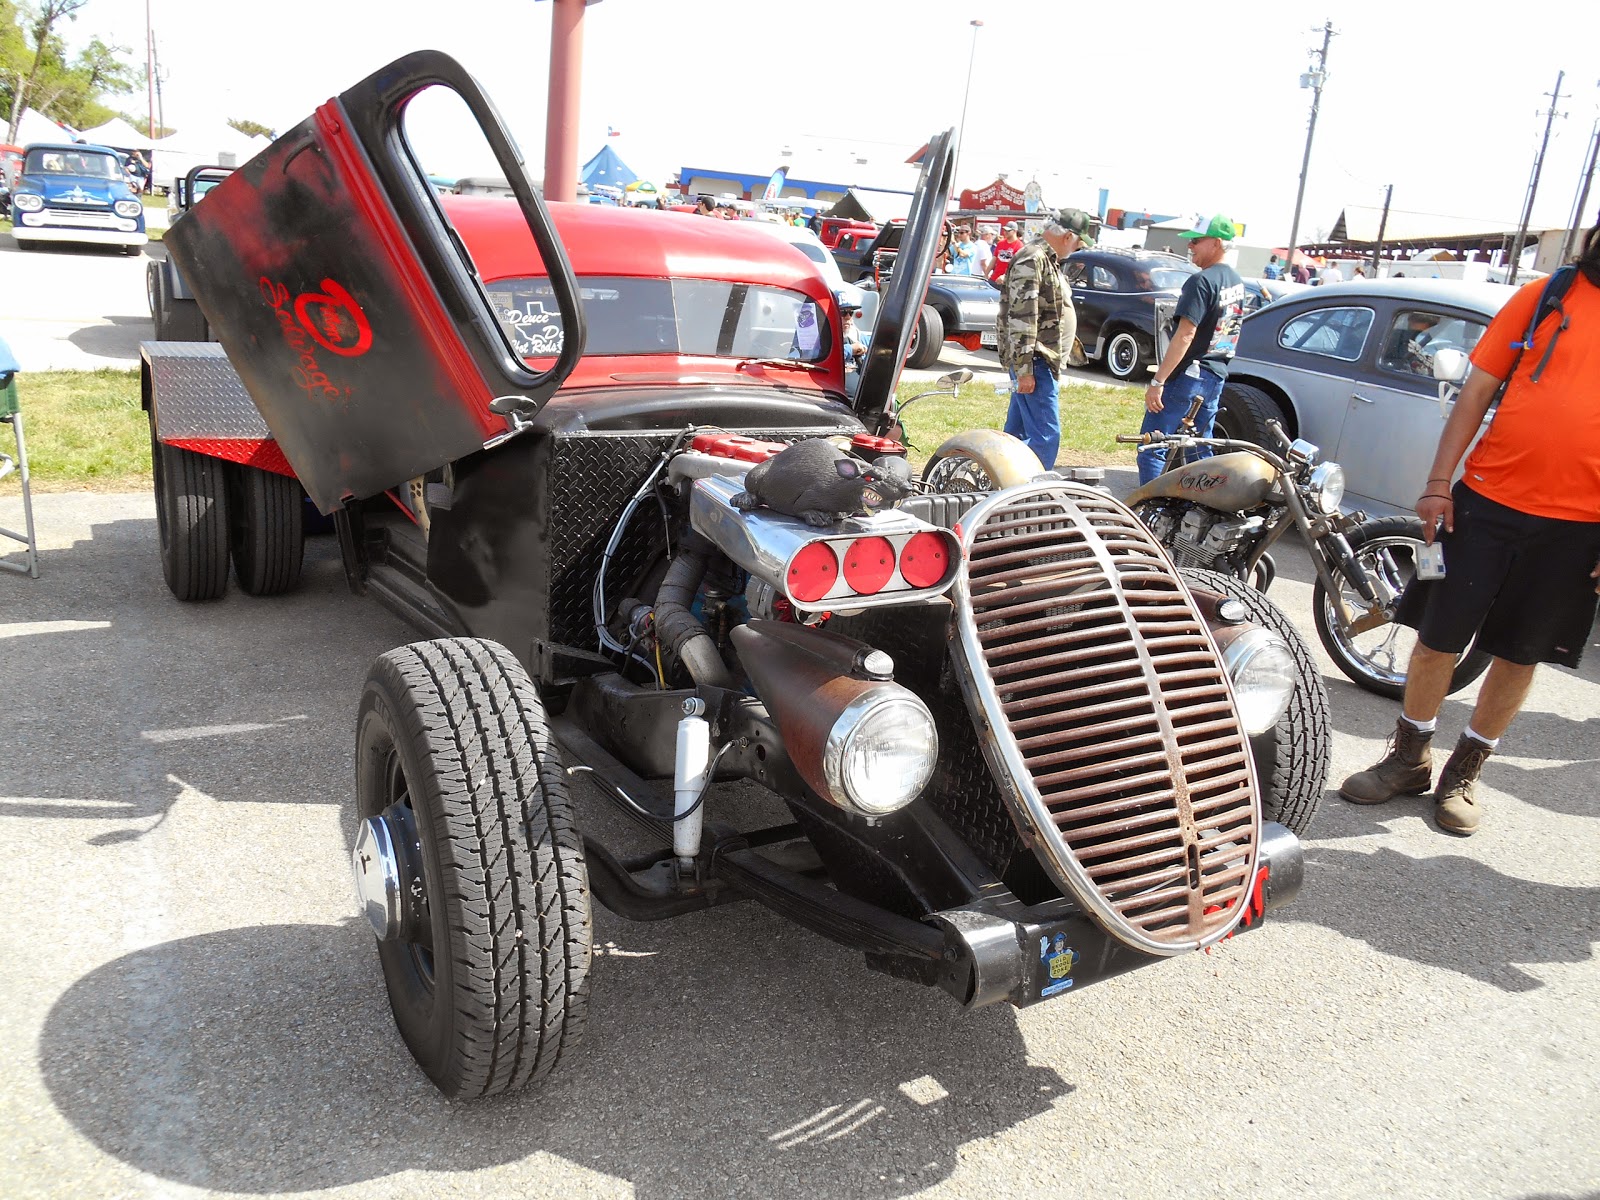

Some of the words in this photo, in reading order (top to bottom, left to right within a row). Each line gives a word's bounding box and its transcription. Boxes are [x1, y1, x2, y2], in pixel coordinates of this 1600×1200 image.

[507, 310, 549, 324] Deuce
[259, 276, 340, 404] Salvage
[531, 340, 558, 354] Rods
[1195, 473, 1220, 492] Rat
[1052, 960, 1069, 970] SKOOL
[1053, 966, 1067, 974] ZONE
